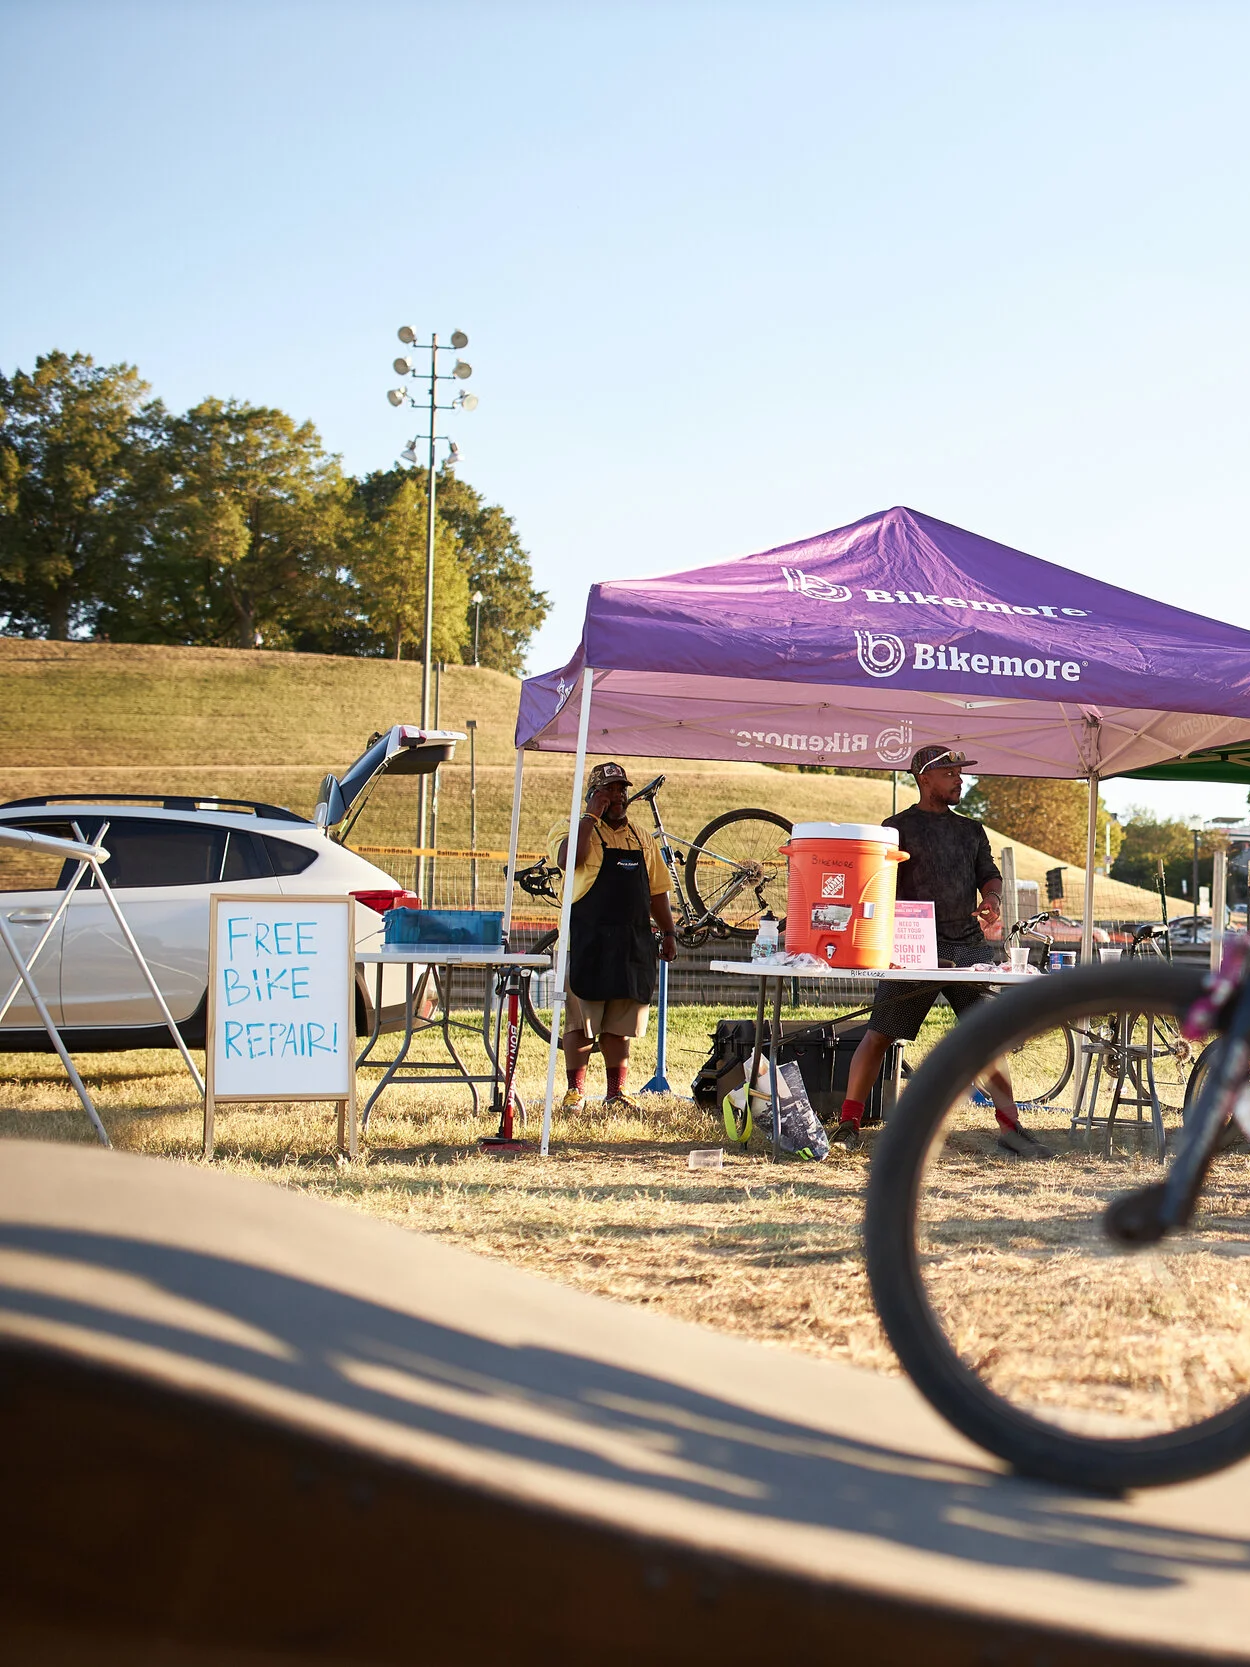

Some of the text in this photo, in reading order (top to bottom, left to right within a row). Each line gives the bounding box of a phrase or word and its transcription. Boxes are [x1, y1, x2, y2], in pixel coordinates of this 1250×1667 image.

[913, 643, 1081, 682] Bikemore
[228, 917, 317, 961] FREE
[894, 944, 926, 954] SIGN IN
[899, 954, 922, 964] HERE
[224, 967, 310, 1007] BIKE
[225, 1020, 338, 1060] REPAIR!
